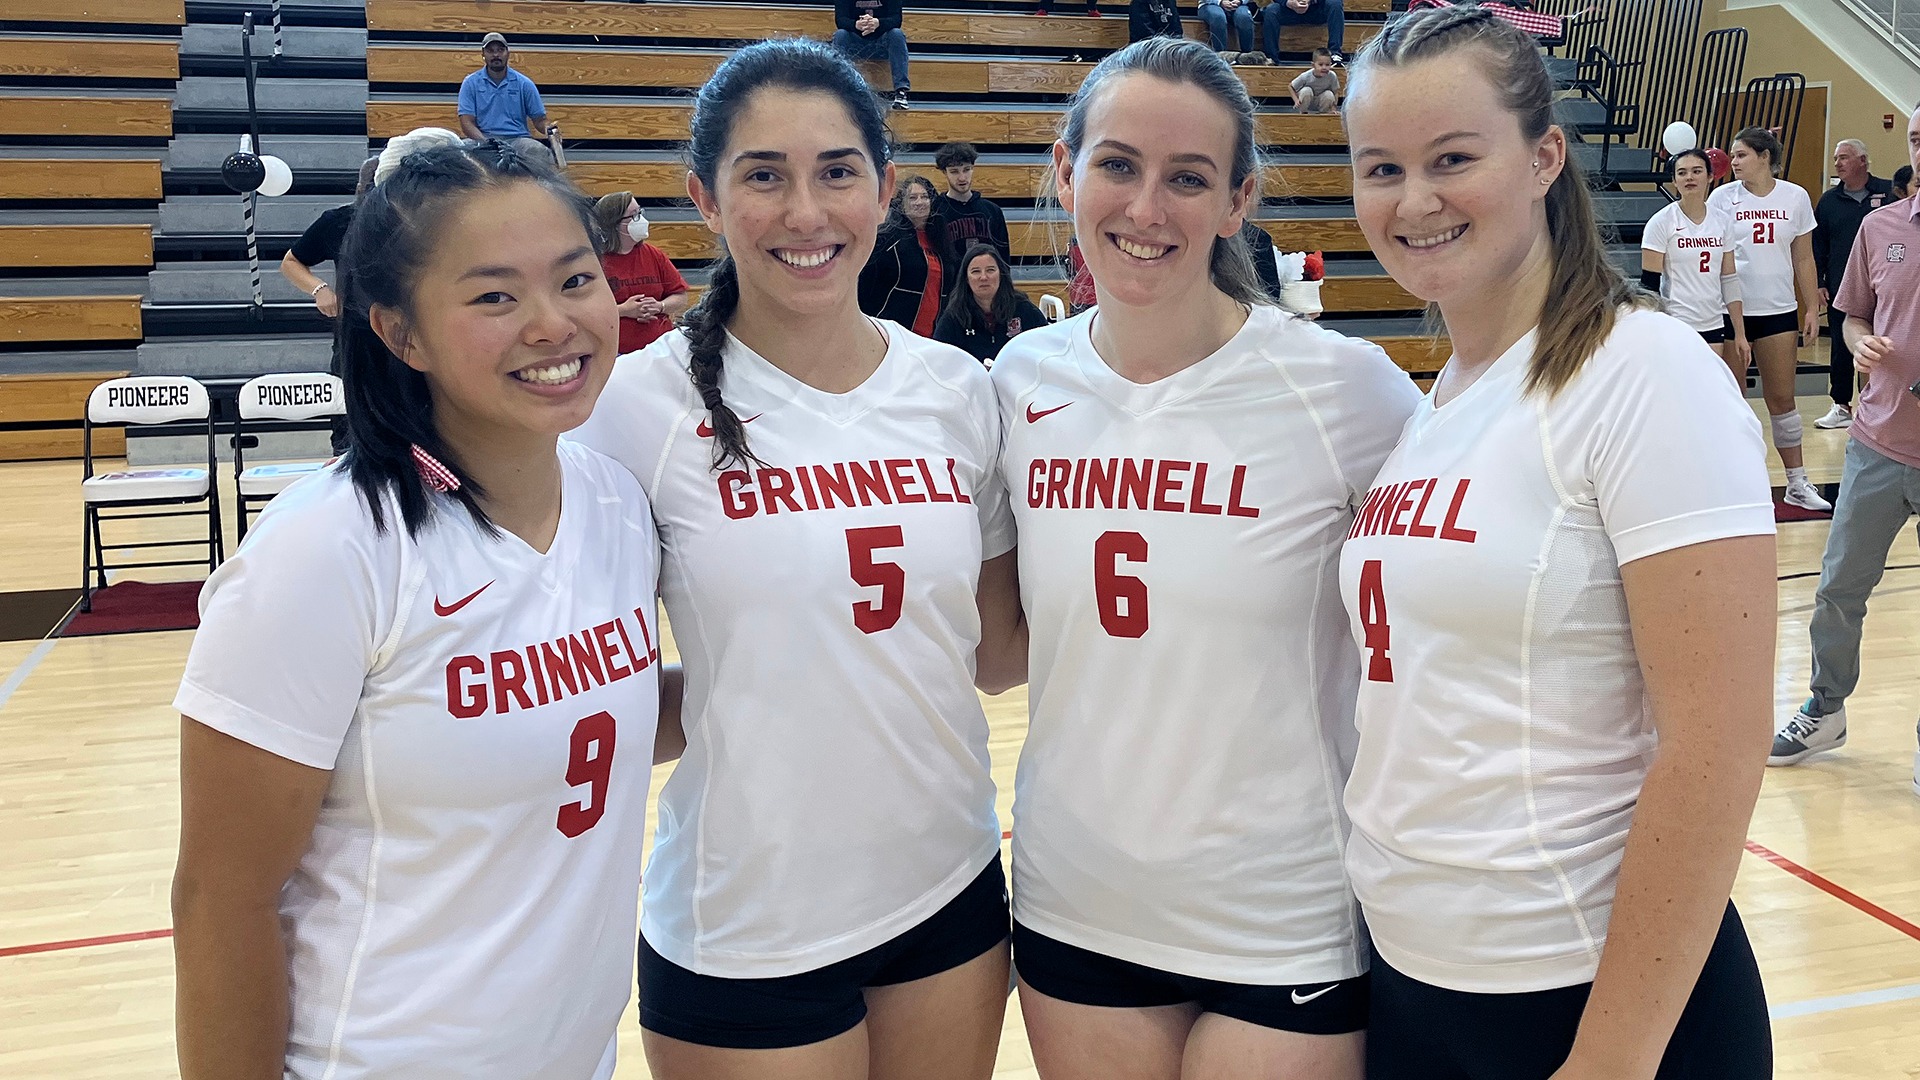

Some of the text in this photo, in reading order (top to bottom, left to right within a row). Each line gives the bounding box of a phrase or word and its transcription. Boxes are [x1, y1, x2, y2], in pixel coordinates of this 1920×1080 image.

[1736, 210, 1789, 221] GRINNELL
[1753, 222, 1775, 244] 21
[1699, 251, 1711, 273] 2
[109, 385, 189, 407] PIONEERS
[258, 383, 332, 406] PIONEERS
[718, 458, 971, 520] GRINNELL
[1027, 458, 1260, 518] GRINNELL
[1346, 478, 1477, 544] INNELL
[845, 524, 906, 634] 5
[1094, 531, 1149, 638] 6
[1359, 560, 1394, 683] 4
[446, 607, 657, 719] GRINNELL
[557, 711, 617, 838] 9
